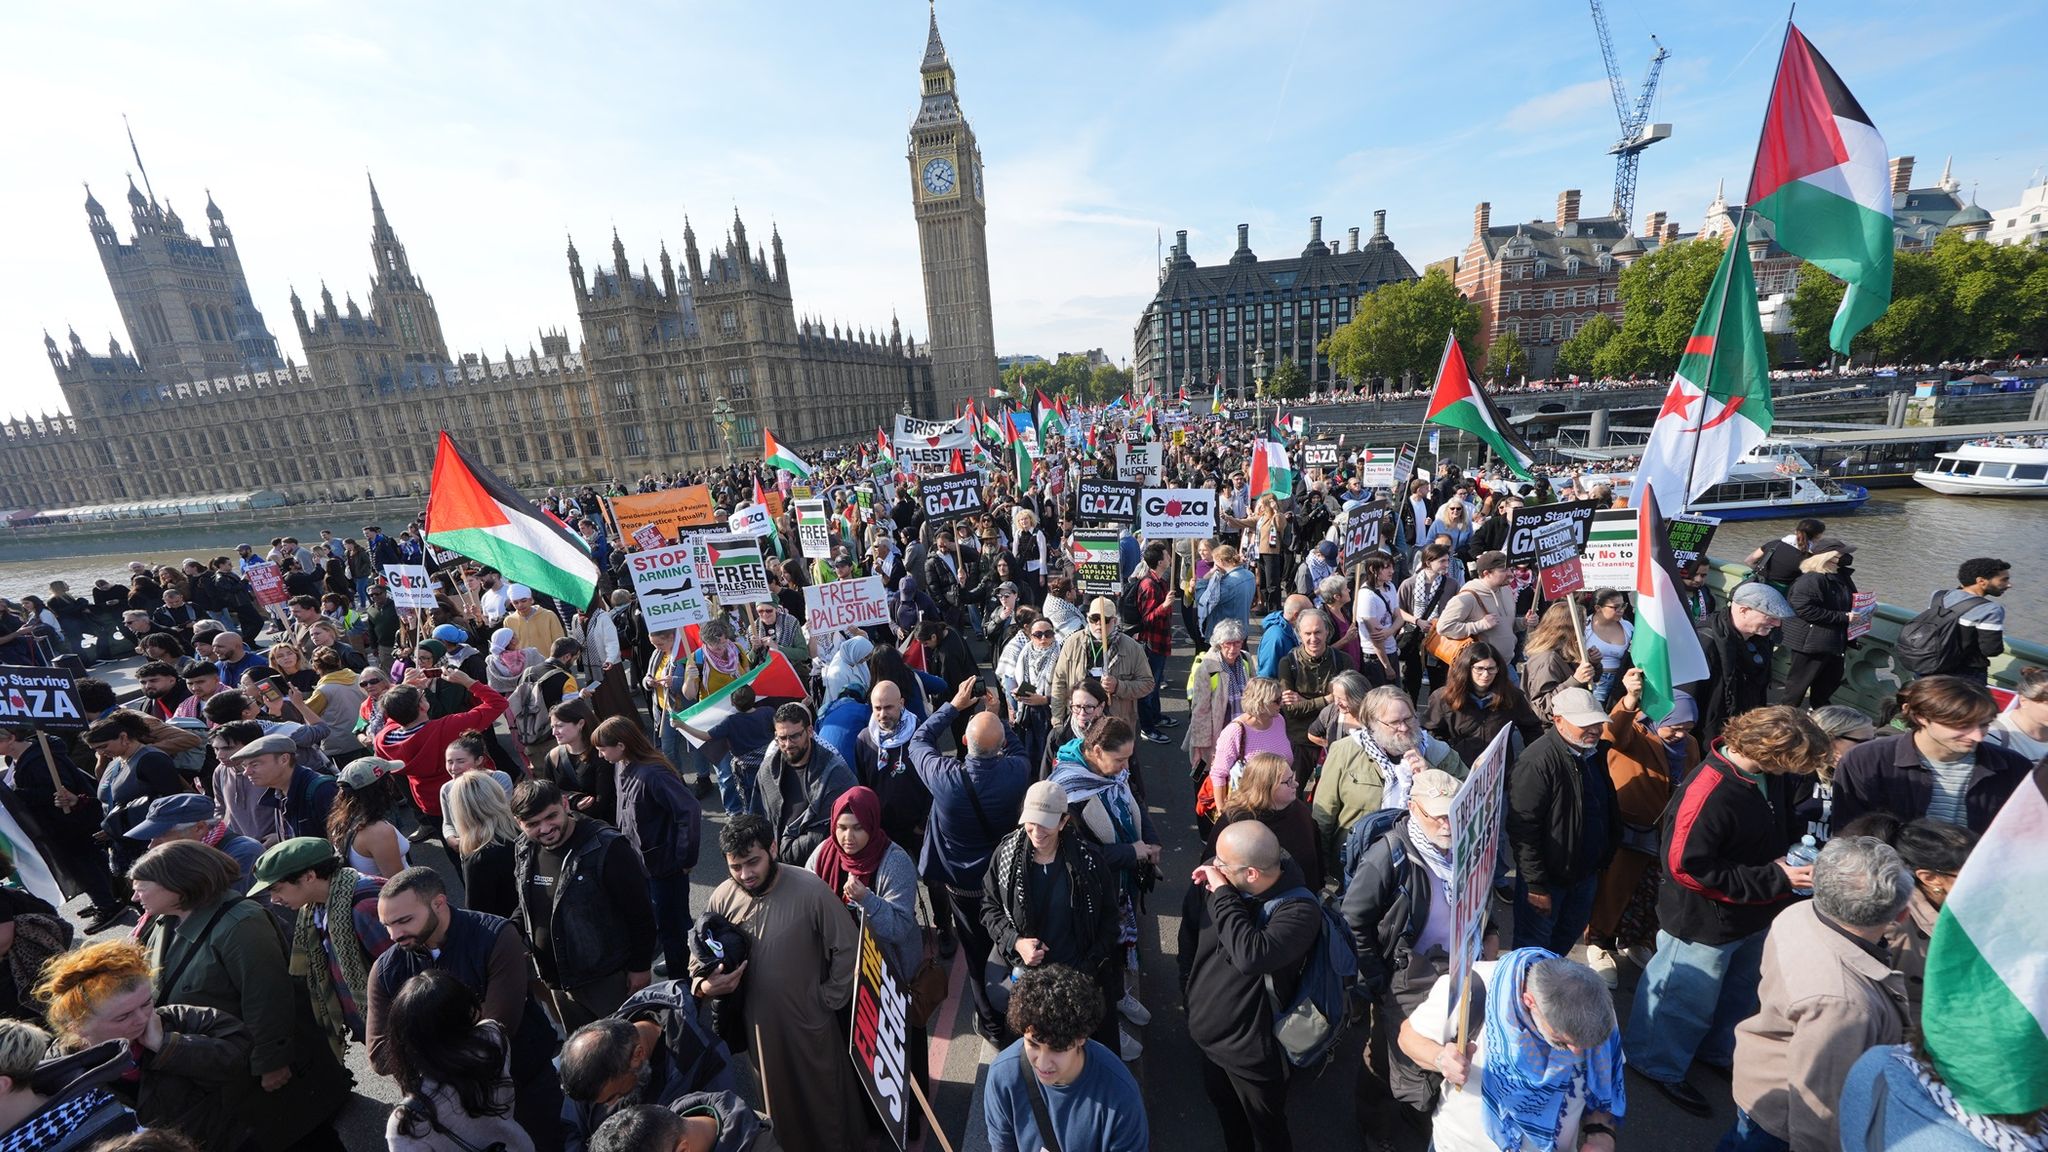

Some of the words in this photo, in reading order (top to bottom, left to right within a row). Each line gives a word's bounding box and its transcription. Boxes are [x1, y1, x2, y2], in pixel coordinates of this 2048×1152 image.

[1125, 453, 1149, 465] FREE
[1305, 450, 1337, 463] GAZA
[1120, 465, 1158, 477] PALESTINE
[923, 484, 942, 494] Stop
[943, 478, 978, 490] Starving
[1081, 484, 1100, 494] Stop
[1102, 484, 1136, 496] Starving
[658, 508, 678, 516] Friends
[684, 503, 708, 511] Palestine
[925, 487, 980, 516] GAZA
[1080, 493, 1134, 516] GAZA
[1145, 497, 1208, 517] Gza
[621, 521, 642, 530] Peace
[677, 511, 707, 522] Equality
[731, 511, 765, 531] Gza
[1146, 520, 1161, 528] Stop
[1175, 520, 1209, 528] genocide
[1516, 515, 1541, 526] Stop
[1544, 508, 1591, 522] Starving
[698, 526, 728, 535] Starving
[800, 525, 827, 539] FREE
[1669, 531, 1691, 542] RIVER
[1692, 533, 1702, 543] TO
[1673, 522, 1695, 533] FROM
[1695, 525, 1711, 535] THE
[1345, 520, 1378, 557] GAZA
[1681, 542, 1695, 551] SEA
[633, 549, 687, 571] STOP
[1540, 545, 1577, 567] PALESTINE
[1581, 552, 1595, 561] ay
[1599, 550, 1616, 558] No
[1620, 550, 1633, 558] to
[389, 571, 428, 589] Gza
[638, 565, 692, 583] ARMING
[713, 563, 765, 584] FREE
[717, 580, 767, 591] PALESTINE
[819, 579, 870, 606] FREE
[646, 598, 701, 617] ISRAEL
[10, 674, 70, 689] Starving
[373, 766, 384, 777] 5
[1455, 787, 1474, 841] FREE
[1472, 736, 1505, 811] PALESTINE
[862, 926, 882, 998] THE
[854, 984, 878, 1075] END
[873, 958, 907, 1124] SIEGE
